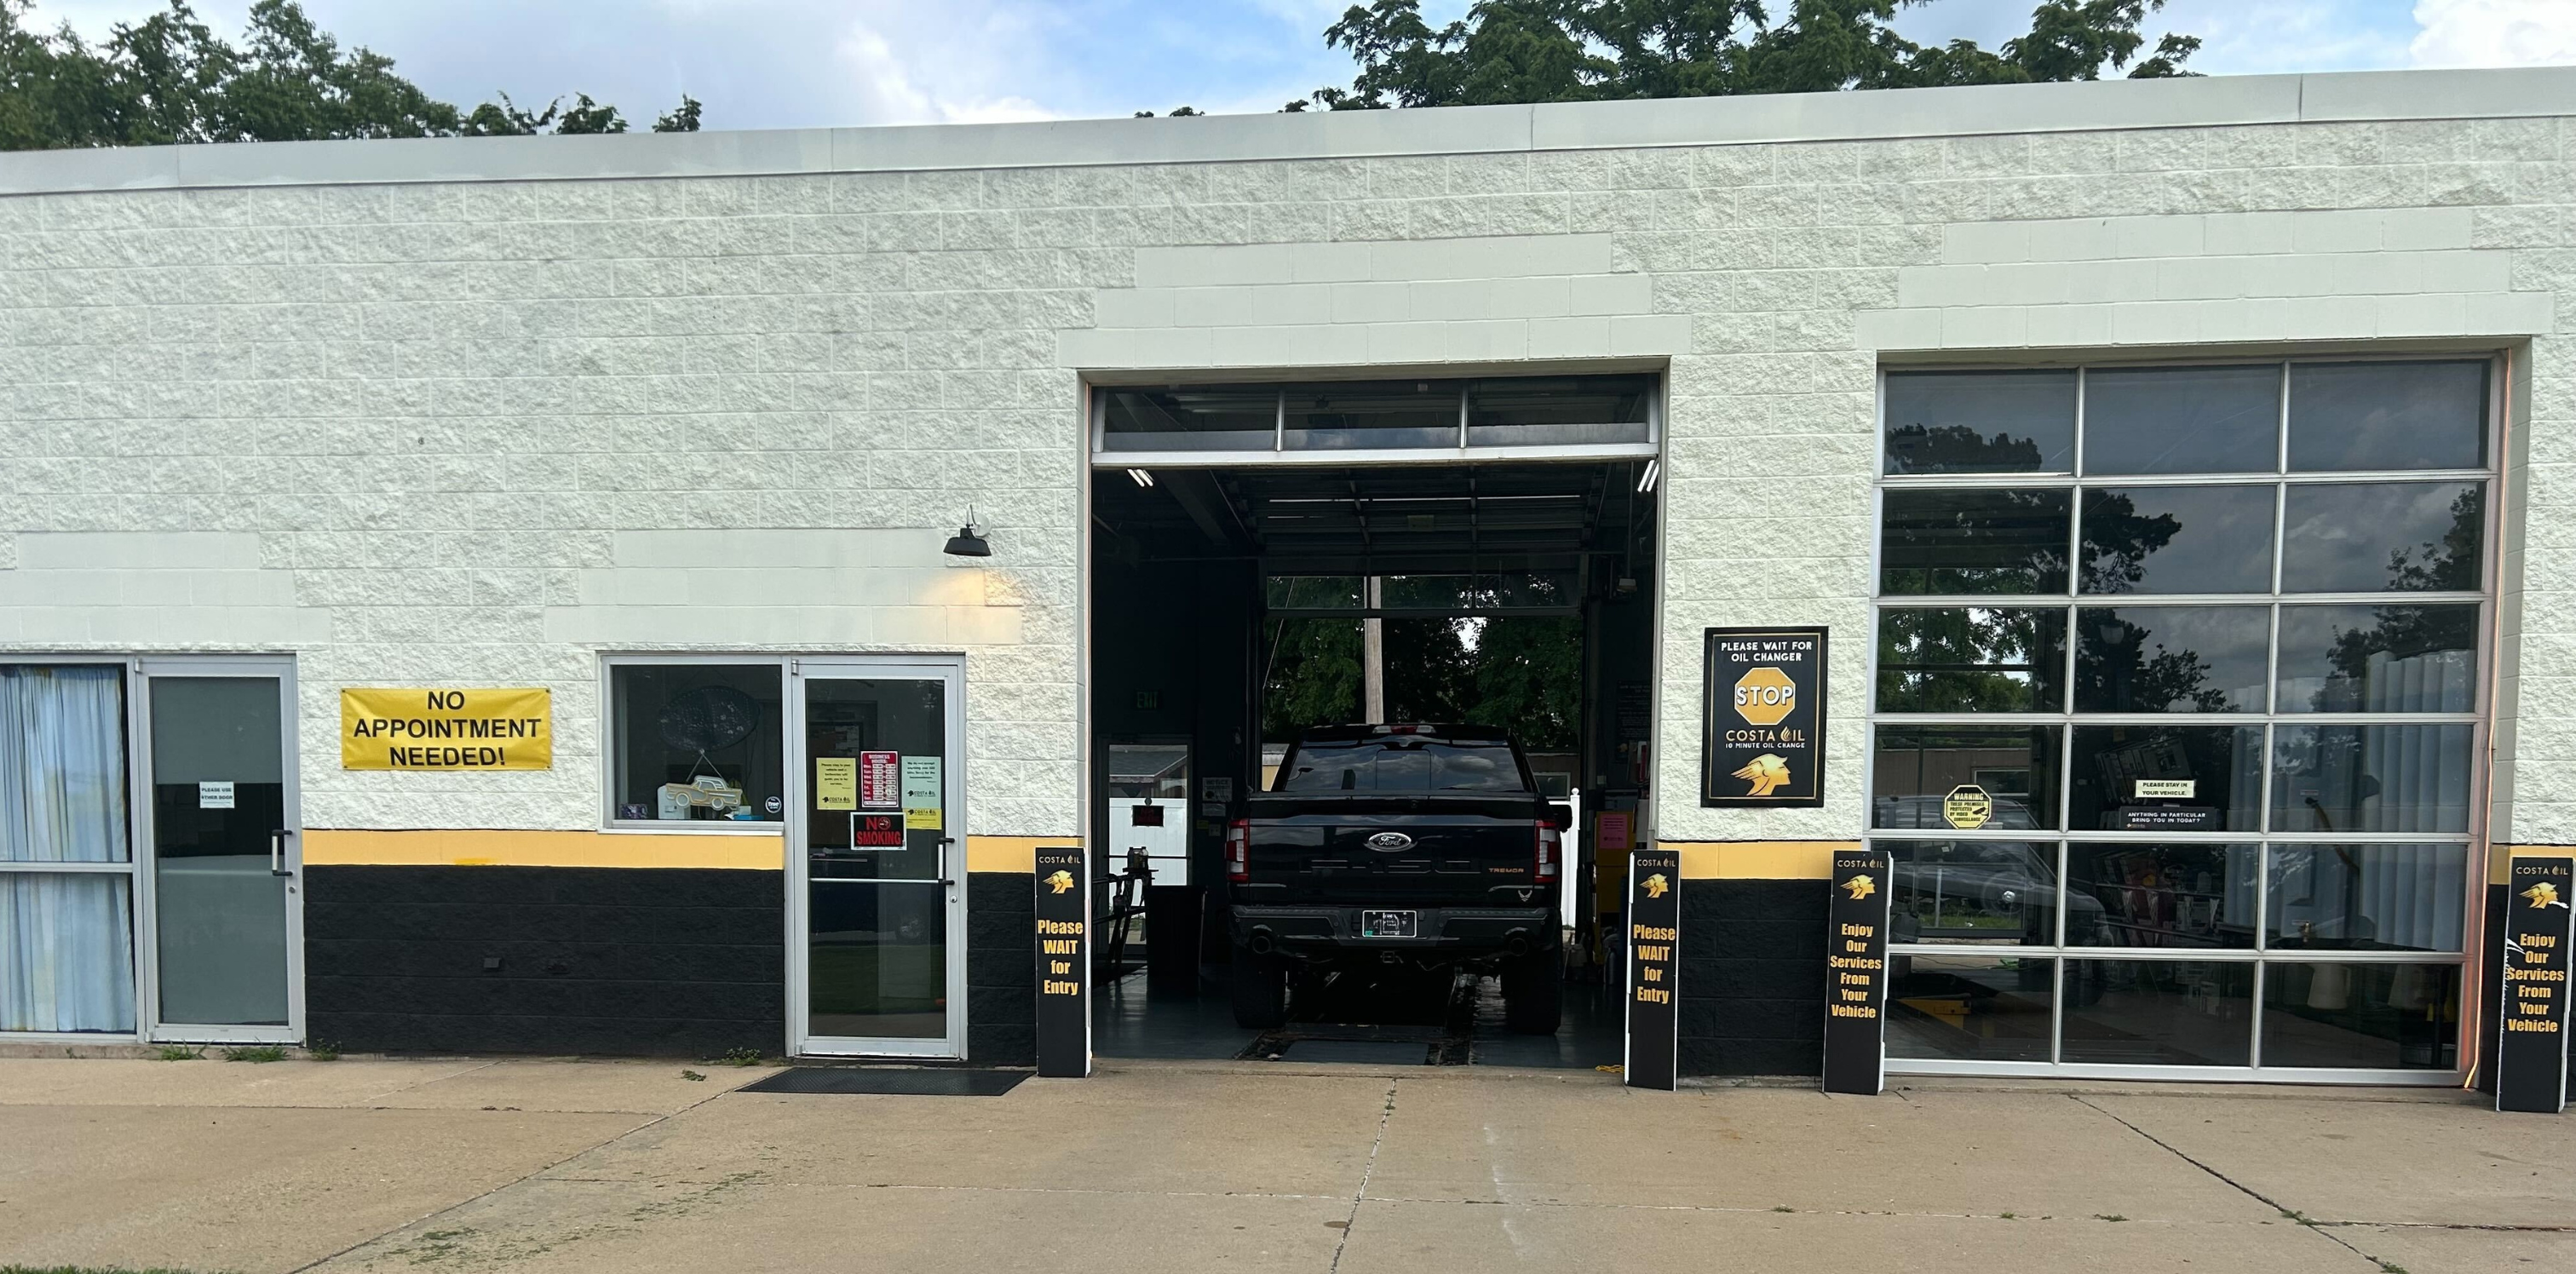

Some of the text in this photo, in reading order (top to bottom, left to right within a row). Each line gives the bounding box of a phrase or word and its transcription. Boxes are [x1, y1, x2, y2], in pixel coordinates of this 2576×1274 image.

[1721, 641, 1813, 651] PLEASE WAIT FOR
[1731, 652, 1802, 662] OIL CHANGER
[428, 691, 465, 710] NO
[1136, 692, 1159, 709] EXIT
[1736, 686, 1793, 706] STOP
[354, 719, 542, 737] APPOINTMENT
[1726, 729, 1775, 742] COSTA
[389, 747, 505, 766] NEEDED!
[857, 831, 901, 845] SMOKING
[1378, 836, 1402, 845] Ford
[1837, 860, 1867, 868] COSTA
[2516, 867, 2549, 875] COSTA
[1038, 920, 1084, 935] Please
[1634, 924, 1676, 940] Please
[1842, 923, 1873, 938] Enjoy
[1043, 940, 1078, 954] WAIT
[1846, 940, 1867, 952] Our
[2520, 933, 2556, 947] Enjoy
[1637, 945, 1670, 961] WAIT
[2525, 950, 2549, 964] Our
[1050, 960, 1071, 974] for
[1831, 956, 1882, 969] Services
[1644, 967, 1663, 981] for
[1840, 973, 1870, 985] From
[2508, 967, 2565, 981] Services
[1044, 980, 1078, 996] Entry
[1637, 986, 1669, 1004] Entry
[1842, 989, 1867, 1001] Your
[2518, 985, 2551, 998] From
[1831, 1005, 1877, 1019] Vehicle
[2519, 1002, 2549, 1015] Your
[2508, 1019, 2557, 1032] Vehicle
